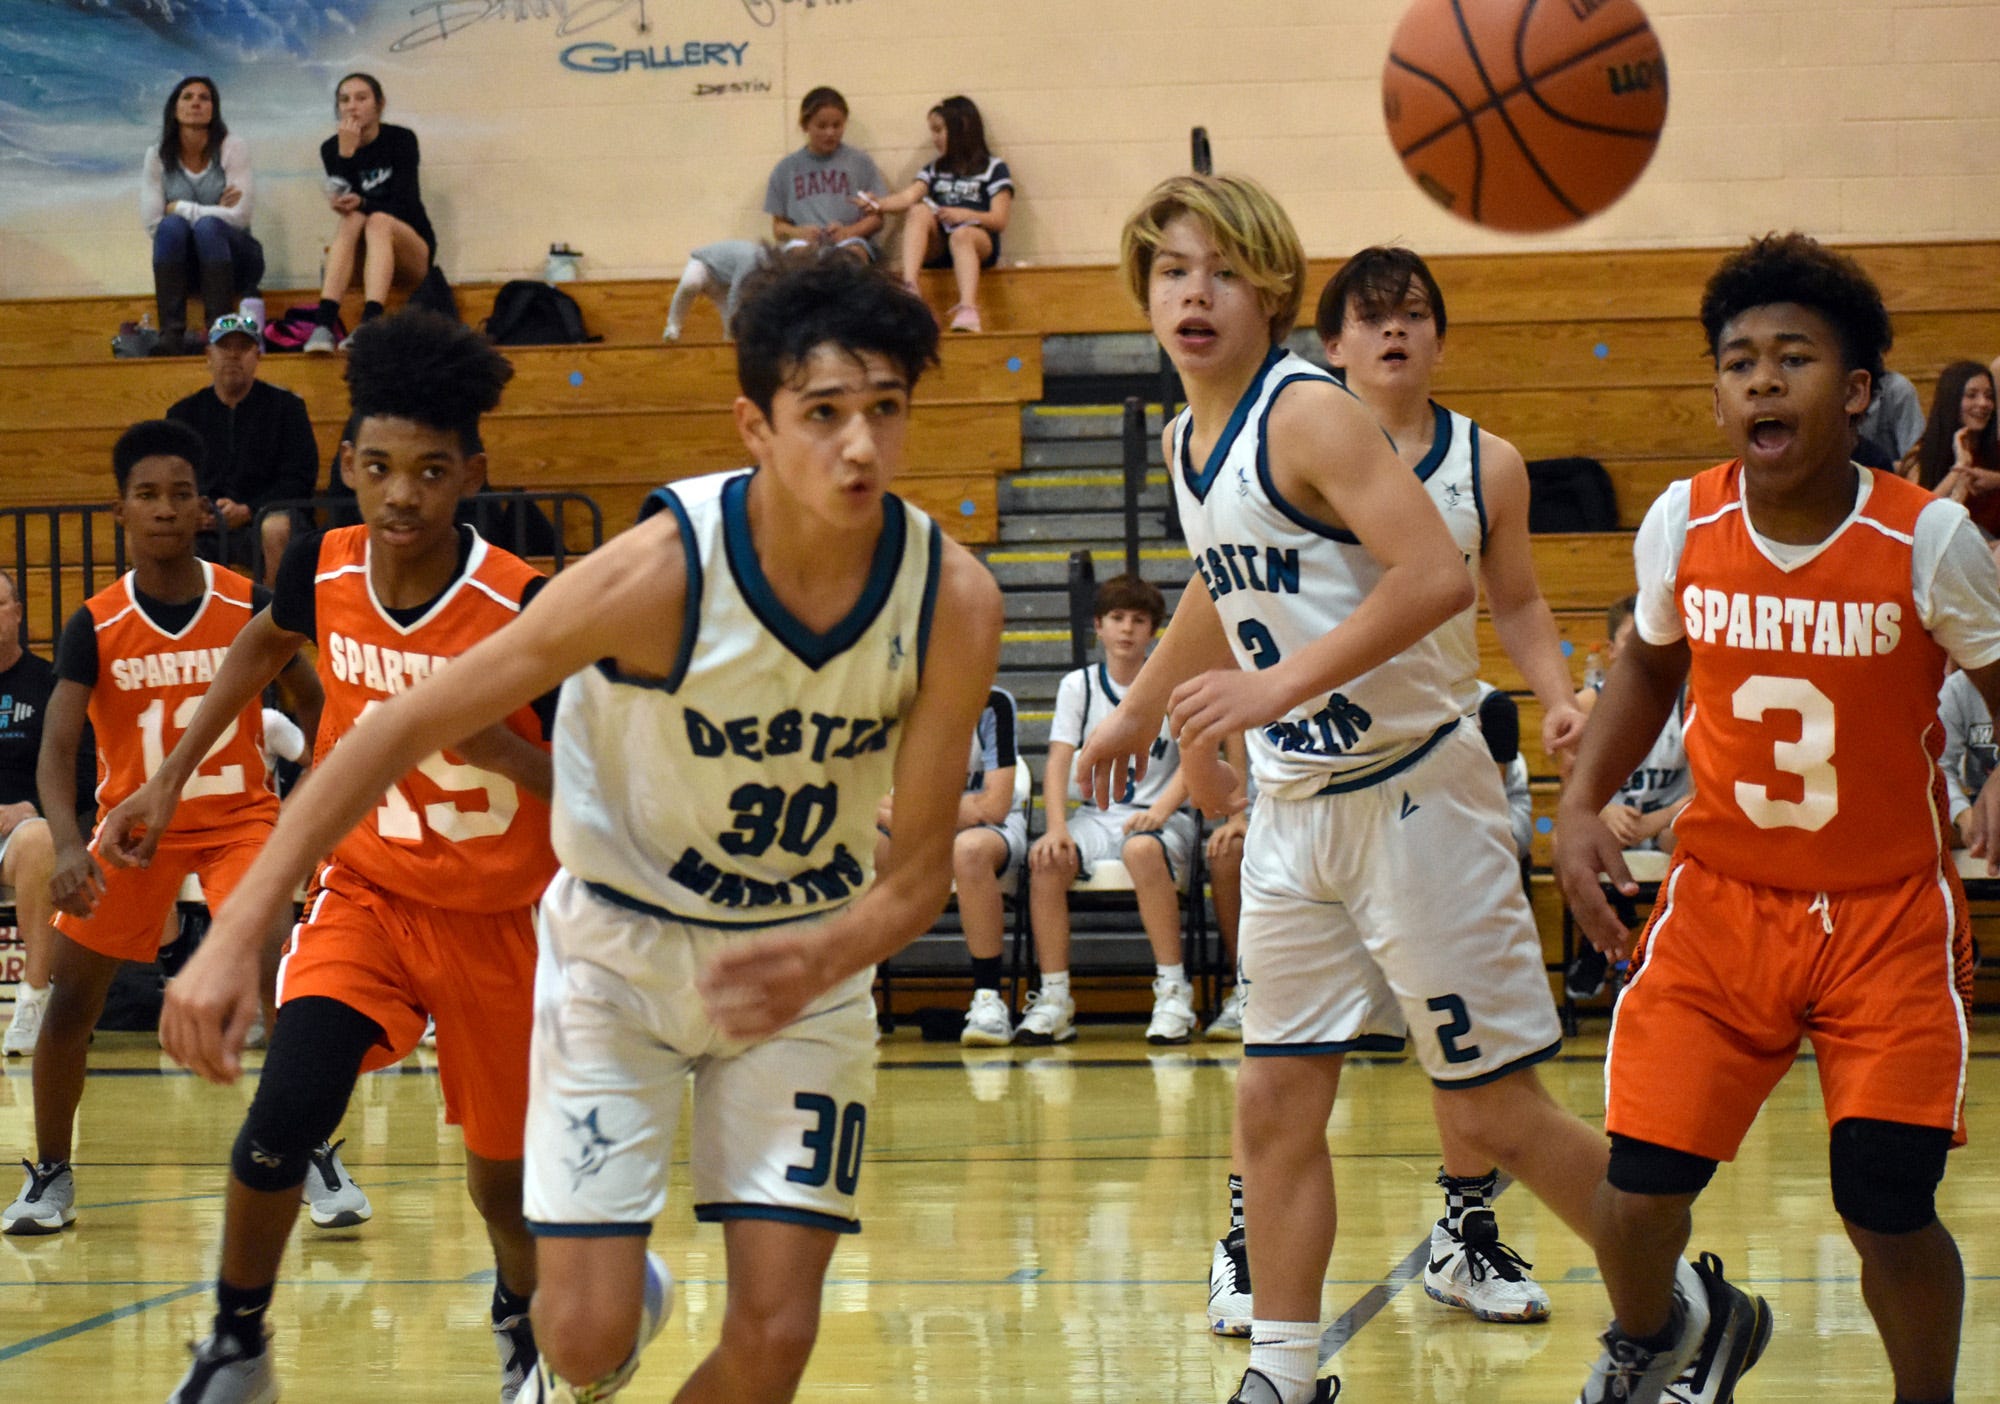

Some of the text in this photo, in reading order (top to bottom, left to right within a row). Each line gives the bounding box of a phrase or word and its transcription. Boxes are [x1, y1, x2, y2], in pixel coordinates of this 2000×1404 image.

[559, 42, 749, 73] GALLERY
[794, 169, 851, 200] BAMA
[1195, 544, 1299, 602] ESTIN
[1682, 585, 1902, 657] SPARTANS
[111, 647, 231, 691] SPARTAN
[329, 632, 448, 696] SPART
[137, 695, 246, 802] 12
[1732, 675, 1839, 832] 3
[718, 782, 838, 857] 30
[1426, 993, 1482, 1064] 2
[785, 1092, 866, 1196] 30
